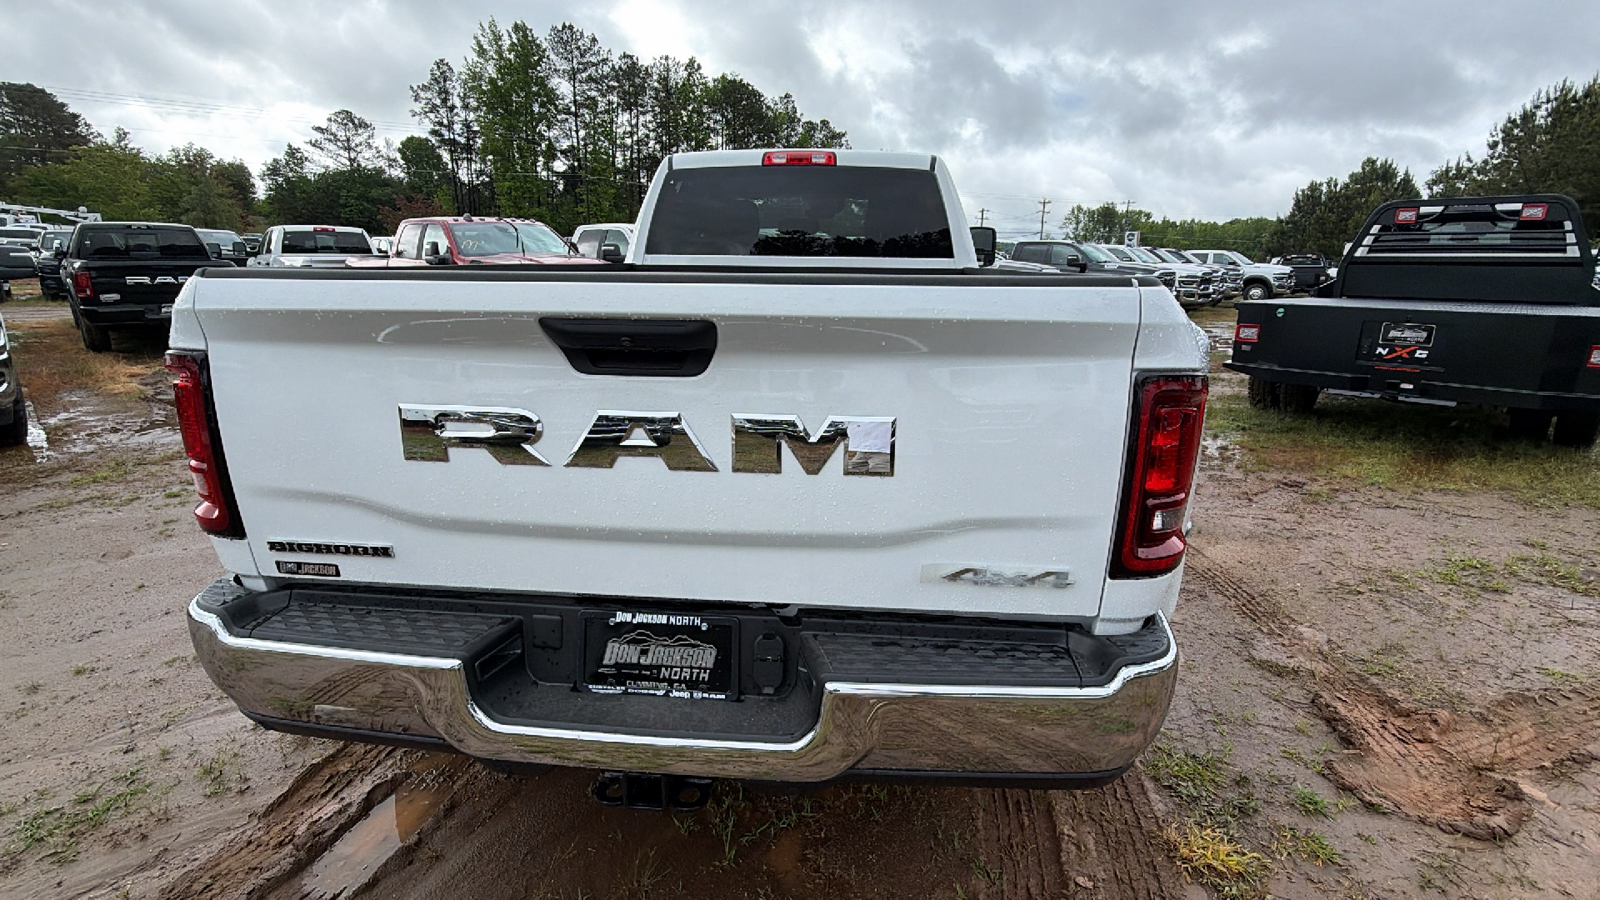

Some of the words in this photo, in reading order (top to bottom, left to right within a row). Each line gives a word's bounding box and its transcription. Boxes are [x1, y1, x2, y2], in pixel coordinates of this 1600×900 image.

[398, 402, 897, 477] RAM
[266, 541, 396, 558] BIGHORN
[299, 562, 337, 576] JACKSON
[669, 616, 701, 626] NORTH
[602, 642, 641, 665] DON
[640, 645, 717, 668] JACKSON
[660, 667, 710, 681] NORTH
[669, 691, 691, 699] Jeep
